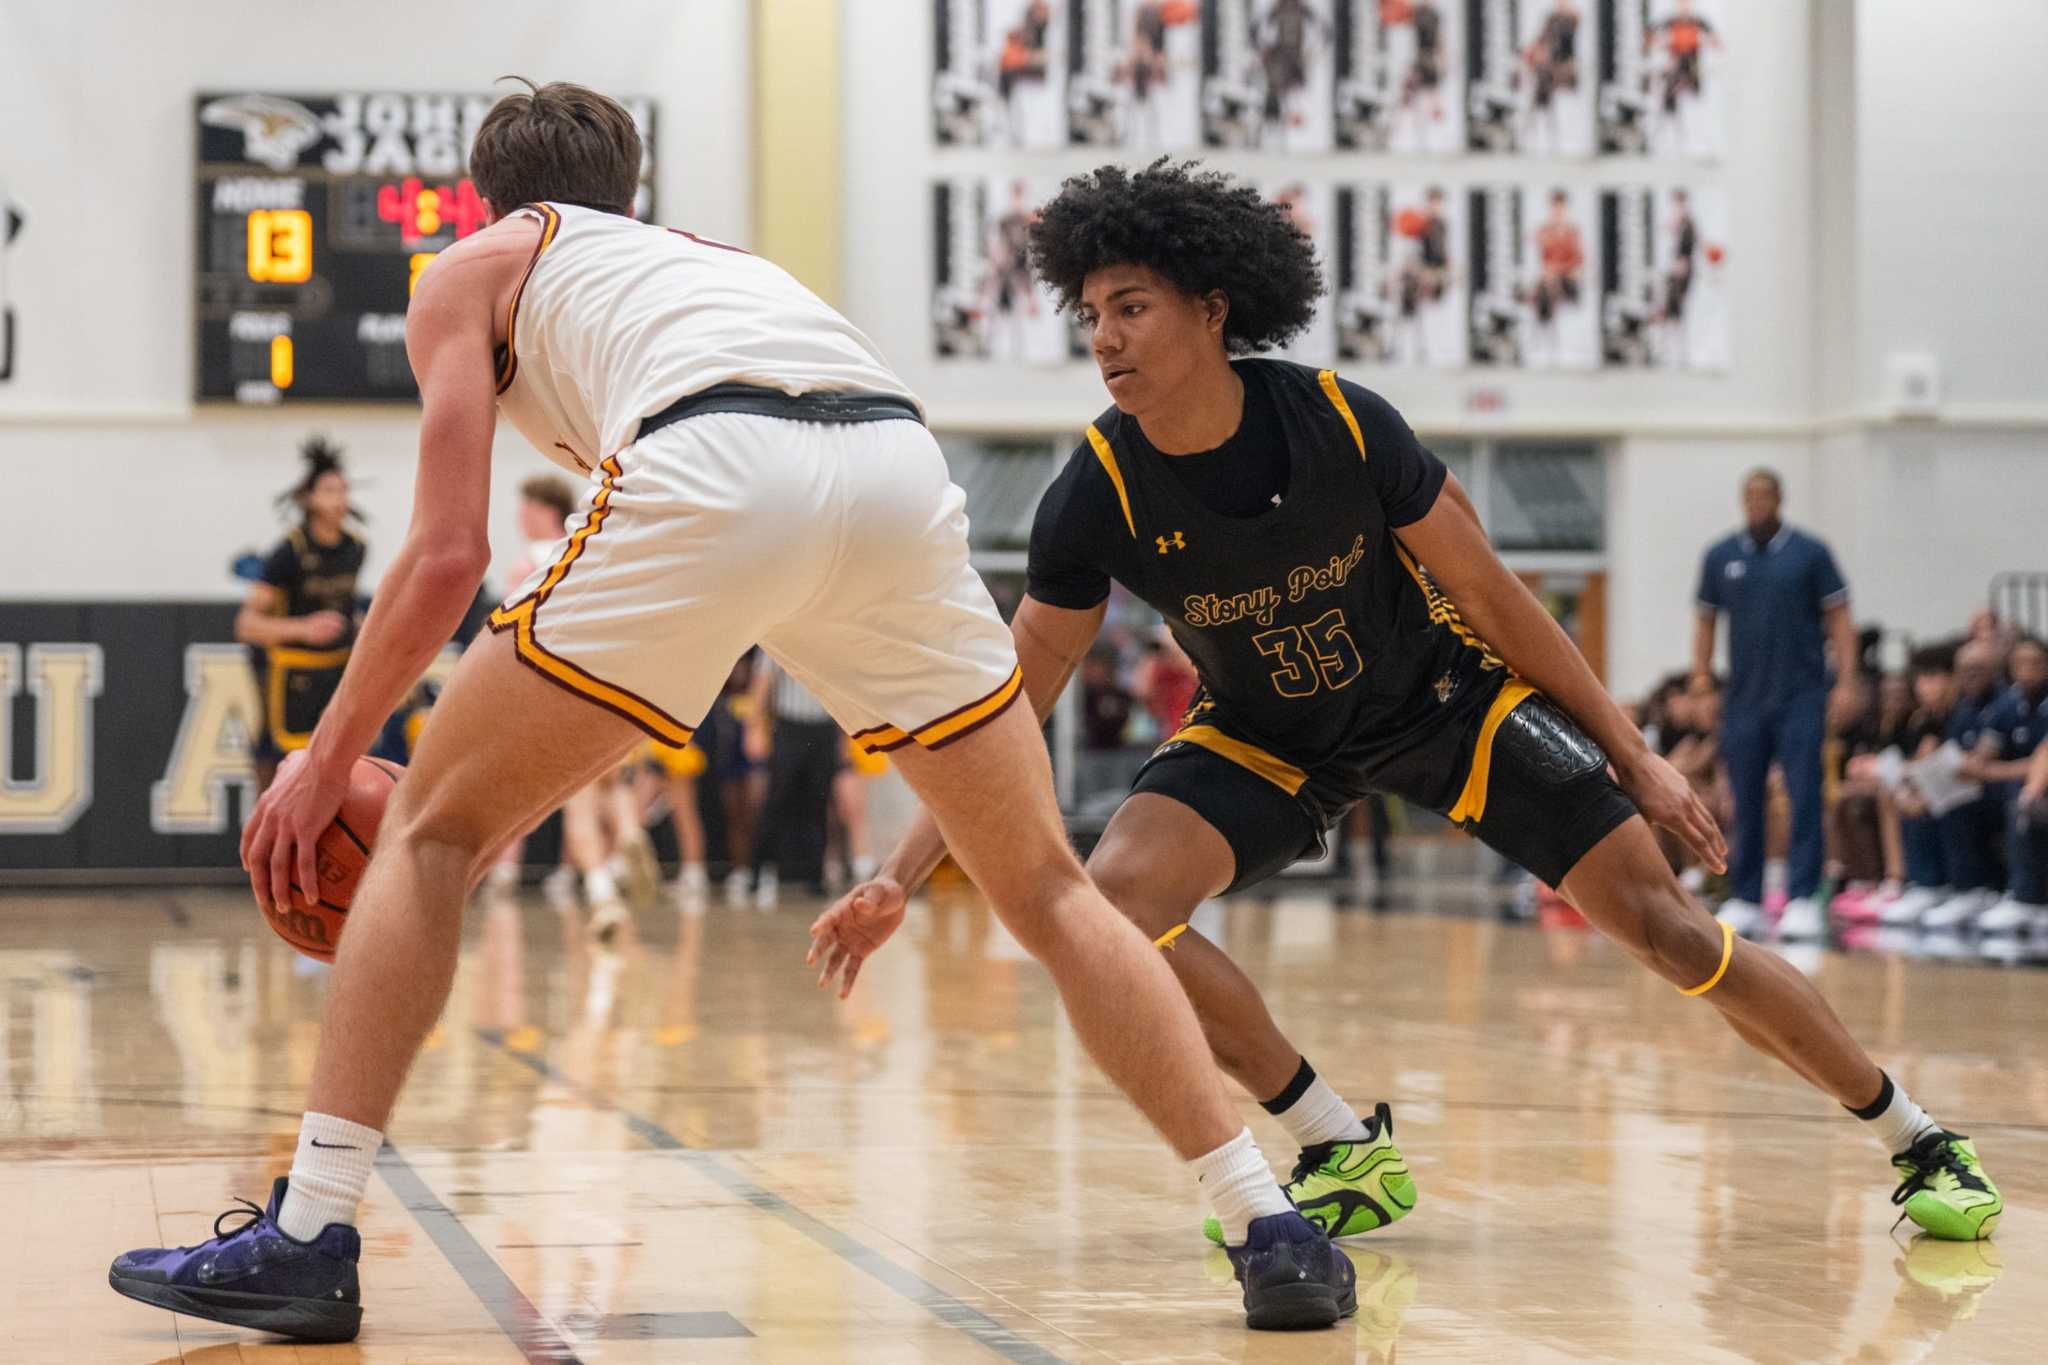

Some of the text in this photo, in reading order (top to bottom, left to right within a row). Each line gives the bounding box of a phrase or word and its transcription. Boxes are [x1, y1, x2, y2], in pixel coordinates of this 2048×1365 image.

[321, 134, 471, 175] JAG
[247, 208, 313, 284] 13
[1184, 586, 1281, 628] Stony
[1252, 608, 1363, 698] 35
